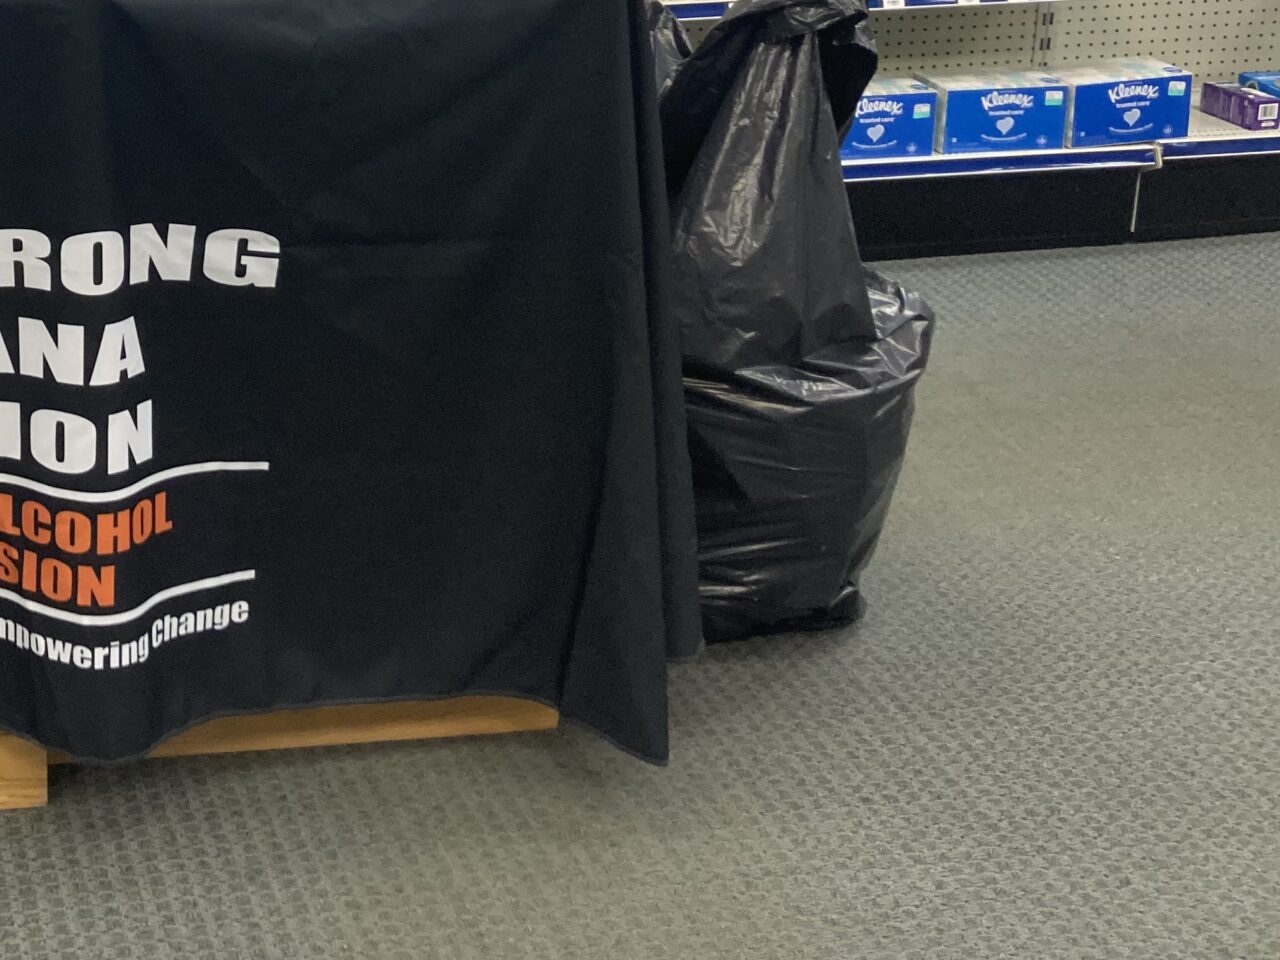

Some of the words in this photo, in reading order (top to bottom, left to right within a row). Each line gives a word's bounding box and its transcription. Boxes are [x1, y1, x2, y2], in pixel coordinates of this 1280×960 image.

[982, 92, 1034, 109] Kleenex
[1109, 83, 1159, 101] Kleenex
[150, 598, 250, 650] Change
